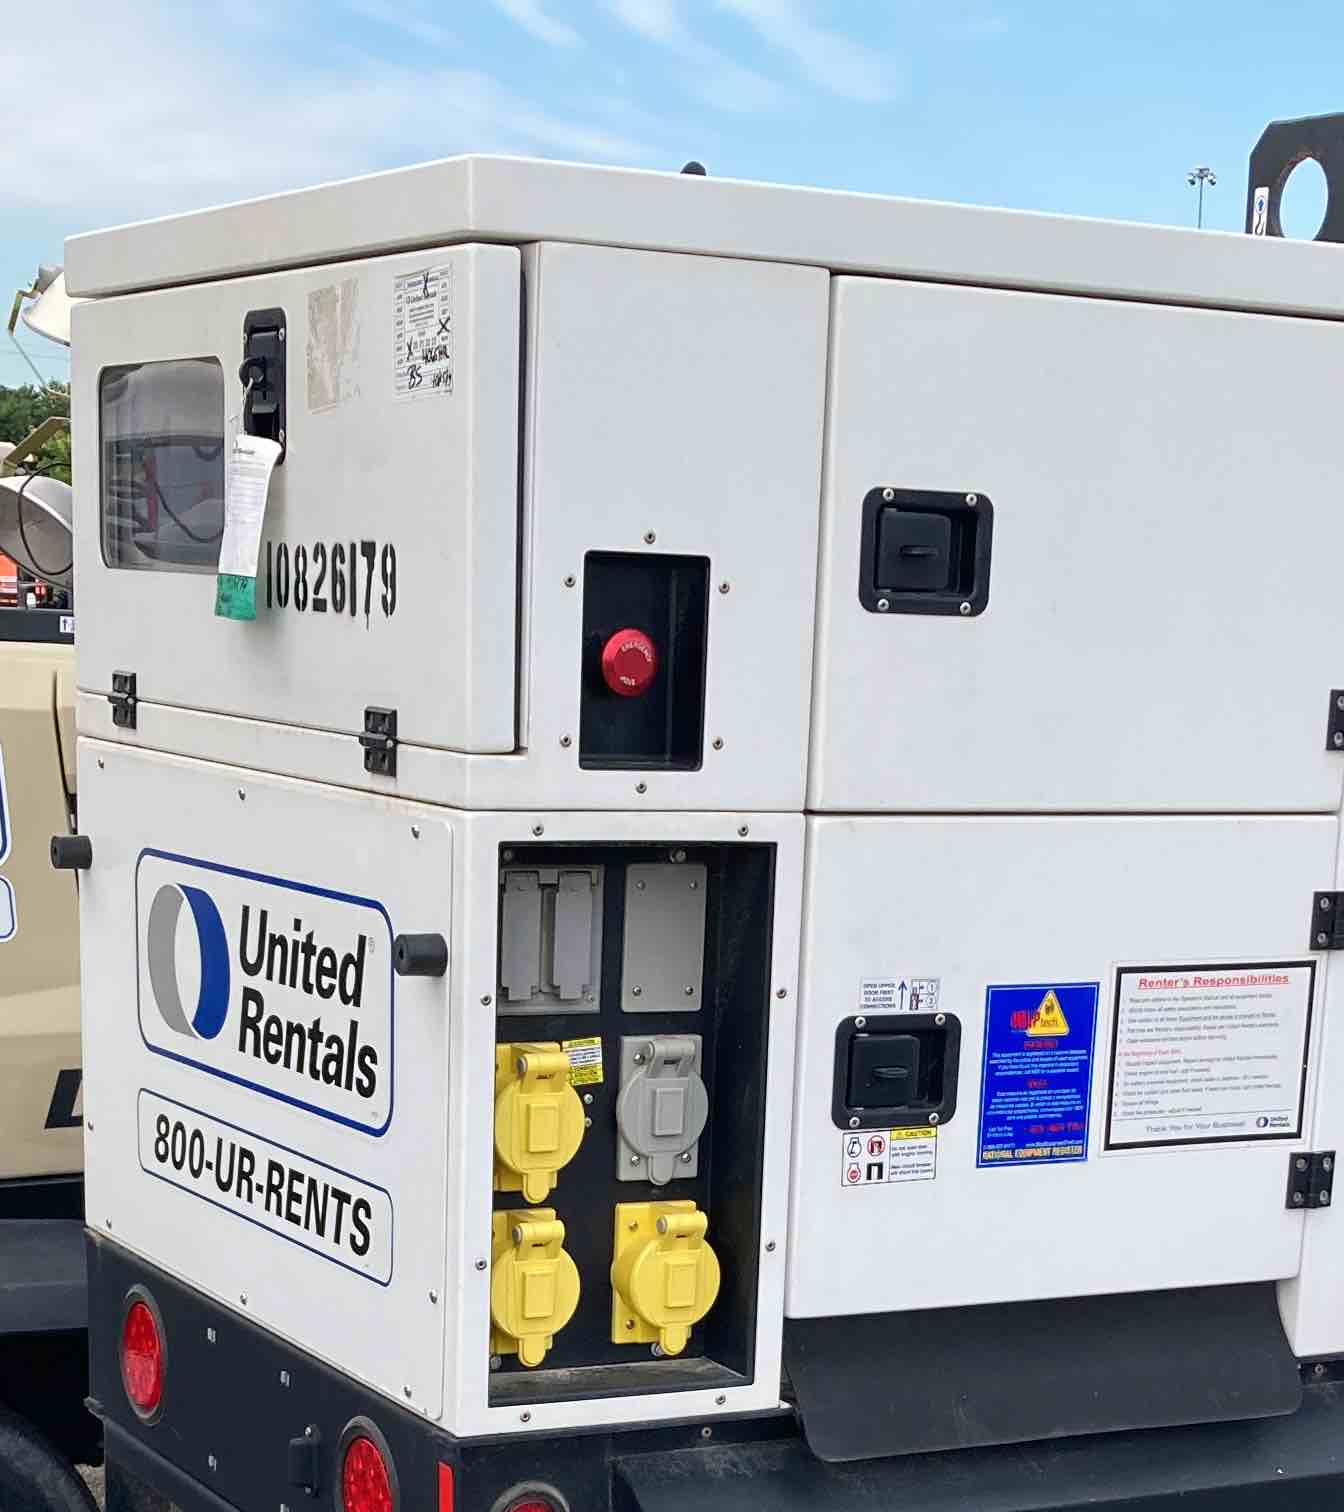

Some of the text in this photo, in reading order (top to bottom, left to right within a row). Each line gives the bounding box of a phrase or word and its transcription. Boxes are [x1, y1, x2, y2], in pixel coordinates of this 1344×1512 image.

[266, 540, 398, 622] 10826179
[239, 904, 367, 1008] United
[1137, 975, 1289, 988] Renter's Responsibilities
[238, 985, 379, 1099] Rentals
[905, 1129, 933, 1137] CAUTION
[154, 1113, 373, 1257] 800-UR-RENTS
